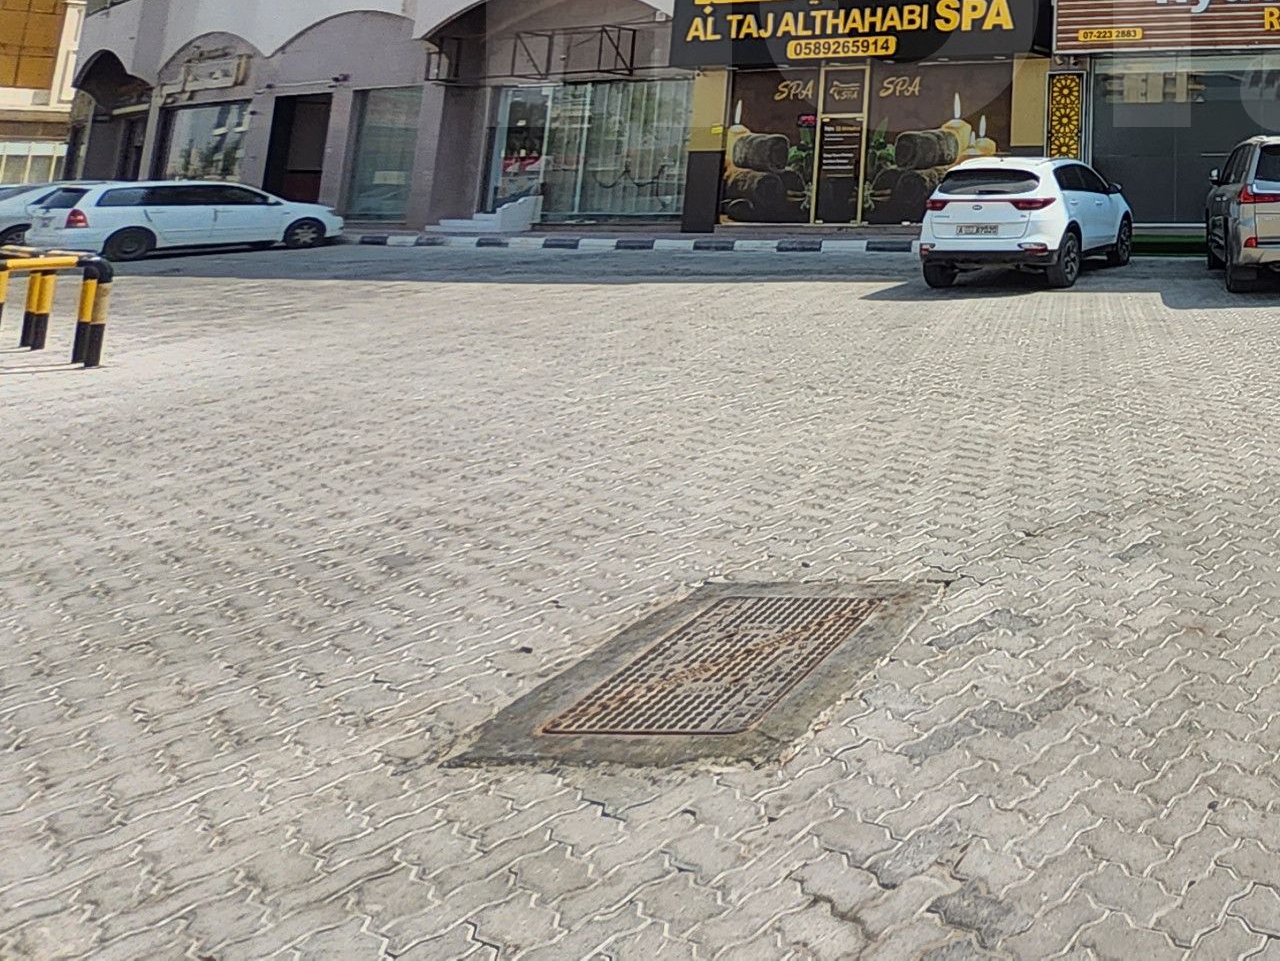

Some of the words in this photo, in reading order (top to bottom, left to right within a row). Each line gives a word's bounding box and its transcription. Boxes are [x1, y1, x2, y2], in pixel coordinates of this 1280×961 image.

[686, 16, 722, 41] AL
[726, 12, 775, 39] TAJ
[776, 3, 929, 37] ALTHAHABI
[1082, 30, 1113, 40] 07-223
[793, 40, 890, 56] 0589265914
[774, 79, 815, 101] SPA
[879, 76, 922, 98] SPA
